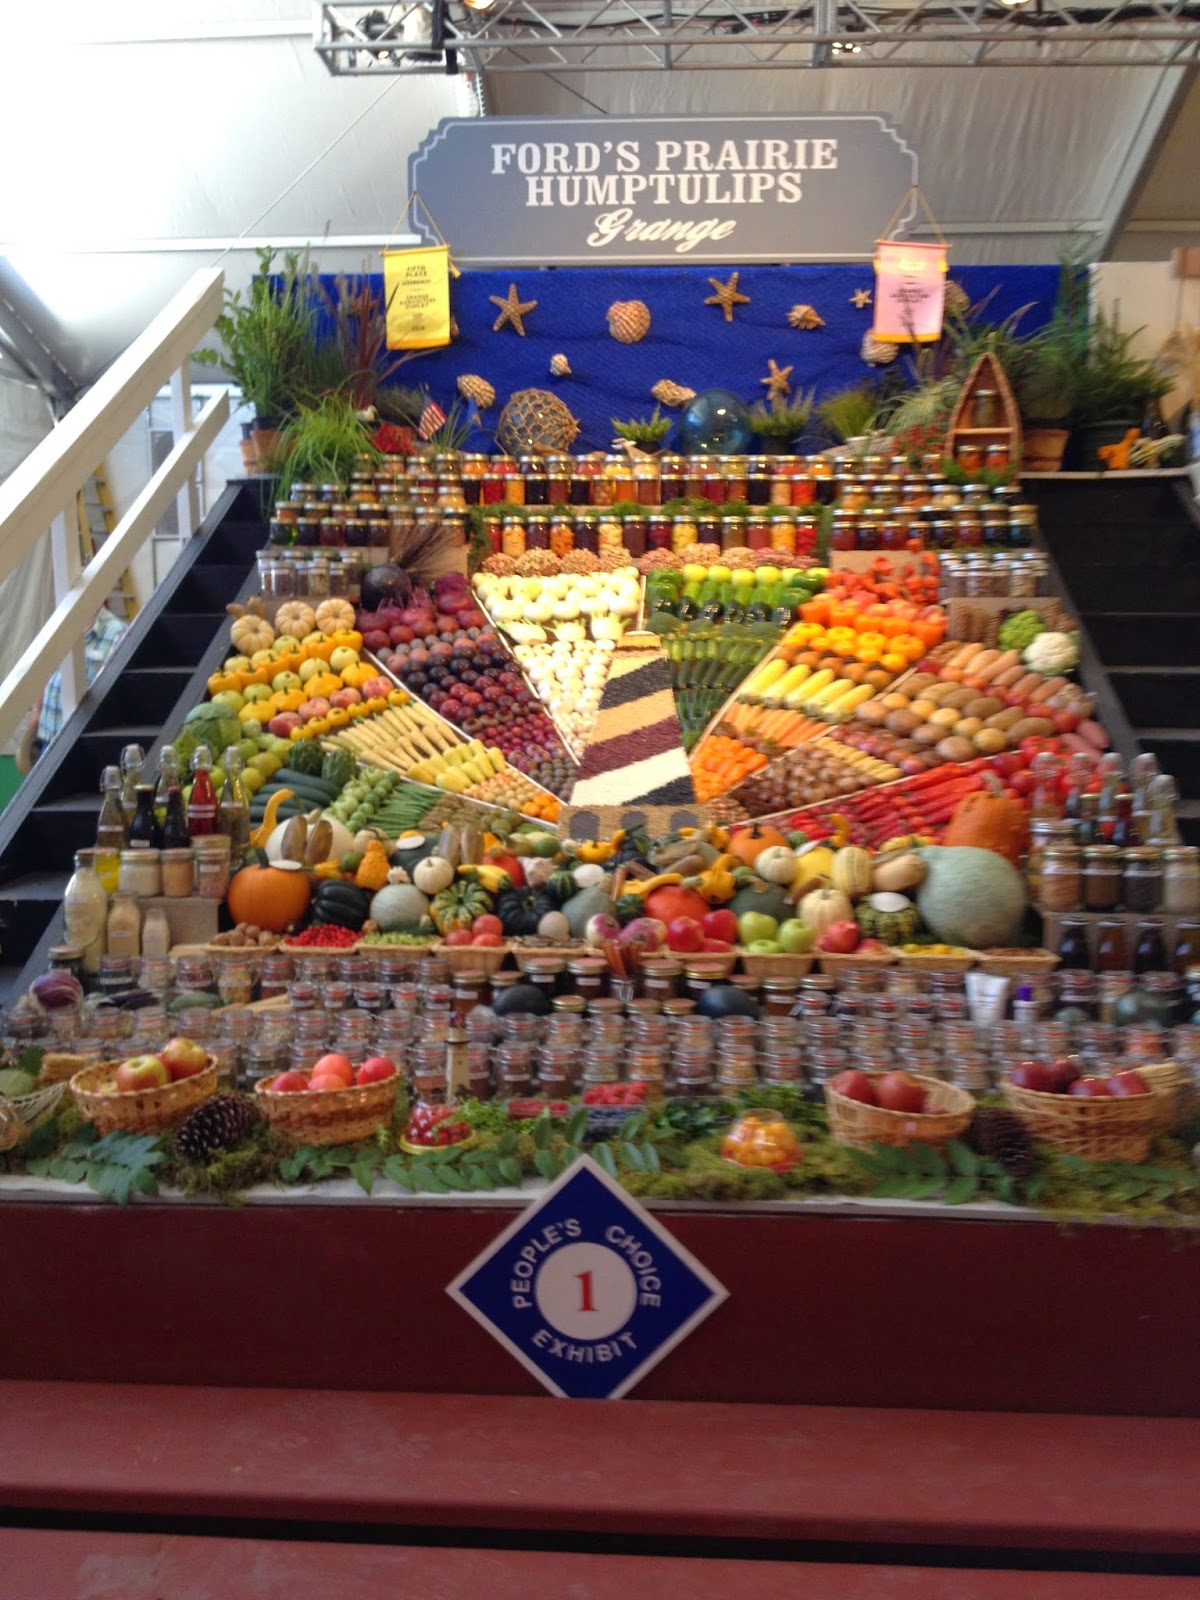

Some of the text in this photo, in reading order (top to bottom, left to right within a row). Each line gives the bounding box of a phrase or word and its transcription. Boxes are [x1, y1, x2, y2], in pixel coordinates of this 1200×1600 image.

[491, 138, 838, 175] FORD'S PRAIRIE
[525, 172, 803, 208] HUMPTULIPS
[587, 209, 735, 251] Grange
[510, 1218, 662, 1309] PEOPLE'S CHOICE
[573, 1270, 600, 1312] 1
[531, 1329, 637, 1363] EXHIBIT
